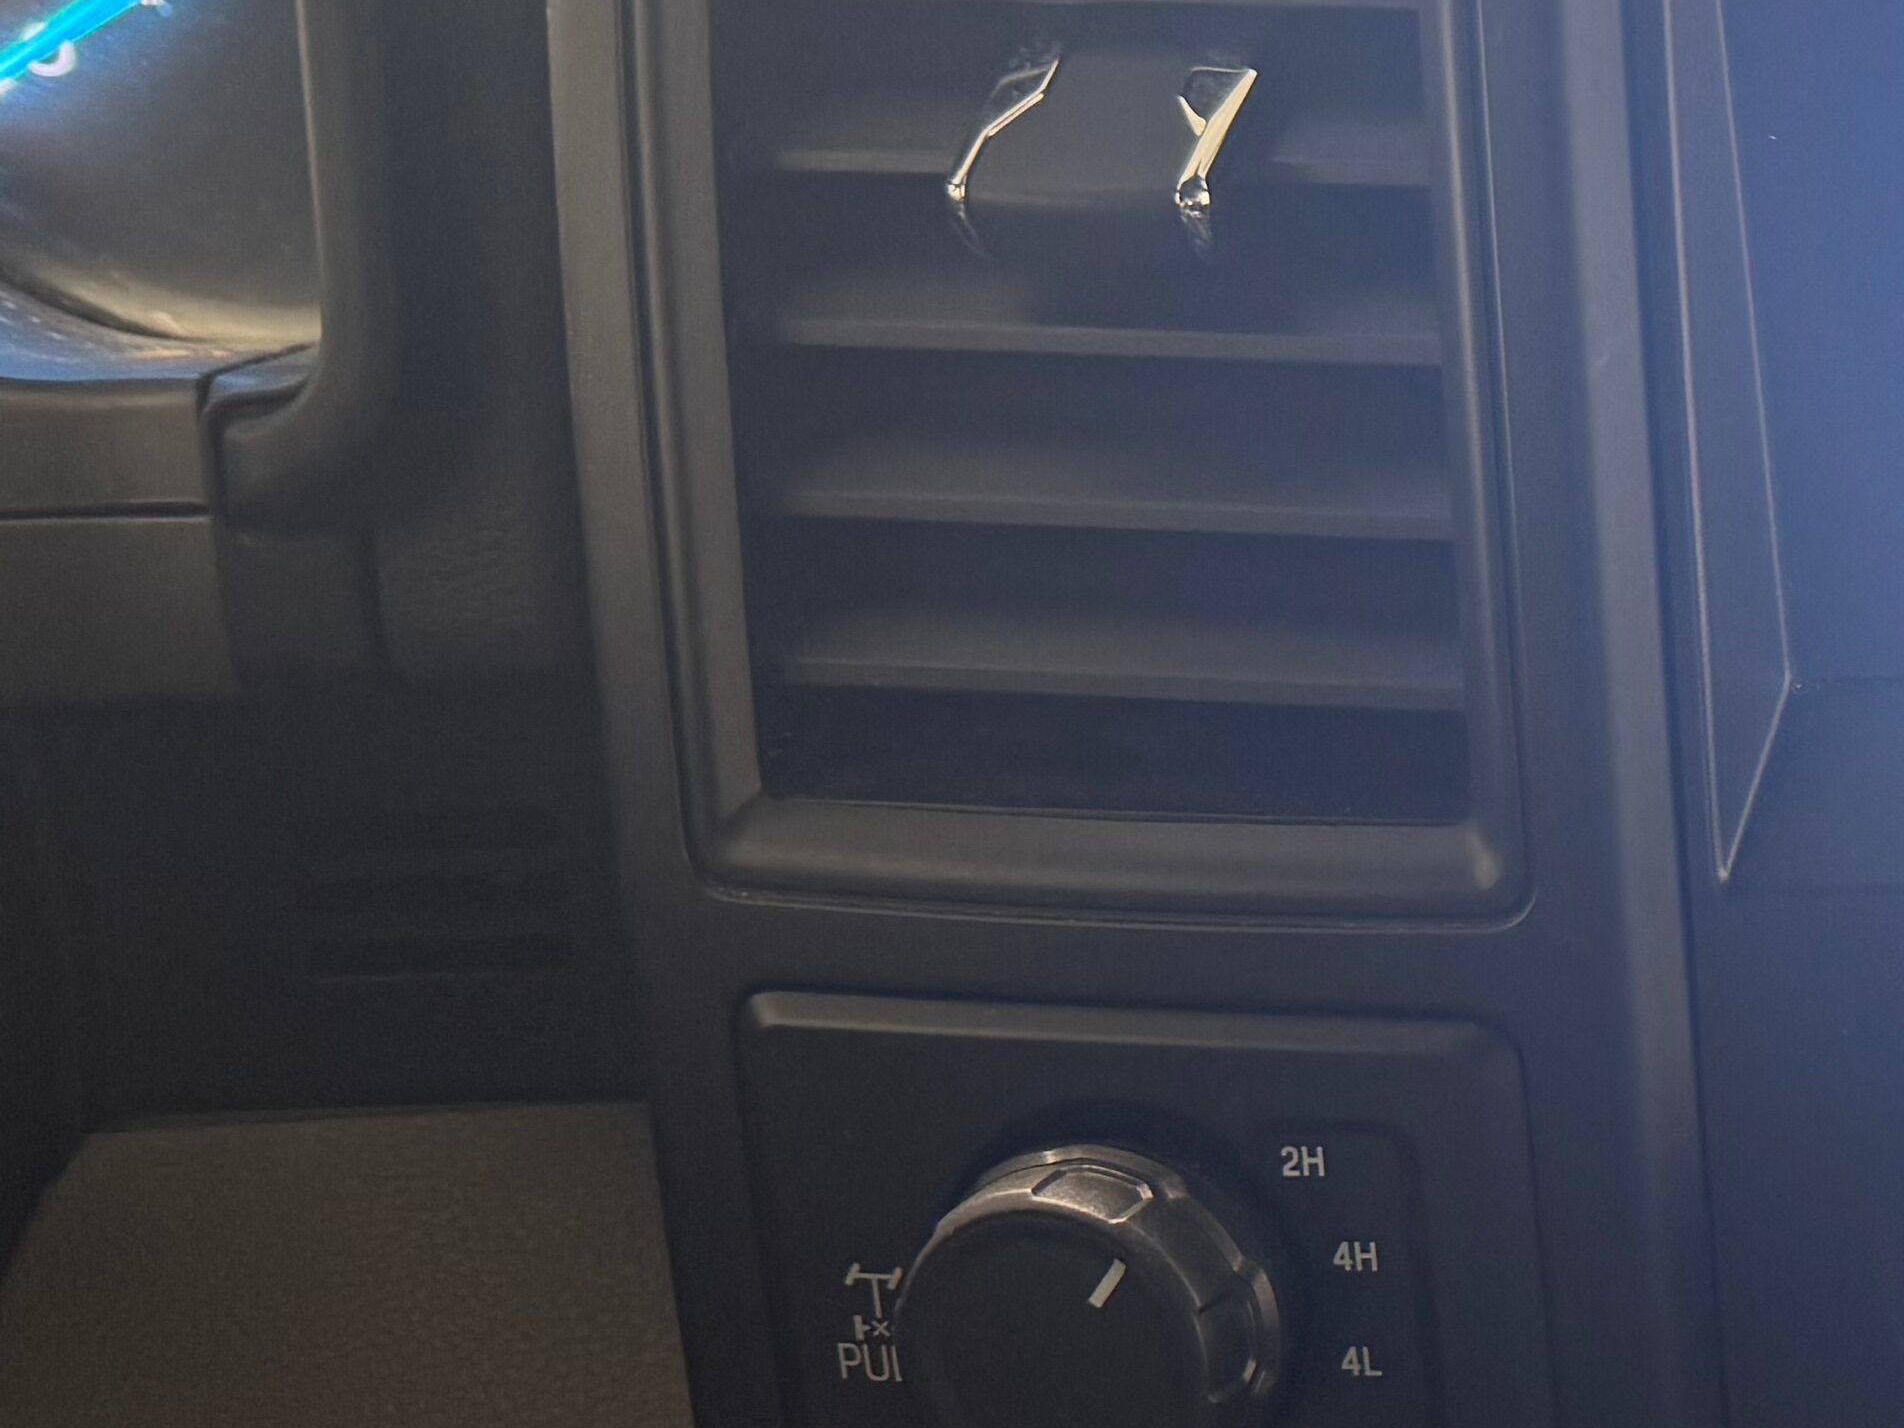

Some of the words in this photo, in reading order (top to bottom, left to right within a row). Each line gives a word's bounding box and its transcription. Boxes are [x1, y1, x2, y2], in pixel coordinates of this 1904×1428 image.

[1280, 1145, 1326, 1180] 2H
[1333, 1240, 1379, 1273] 4H
[1341, 1346, 1383, 1378] 4L
